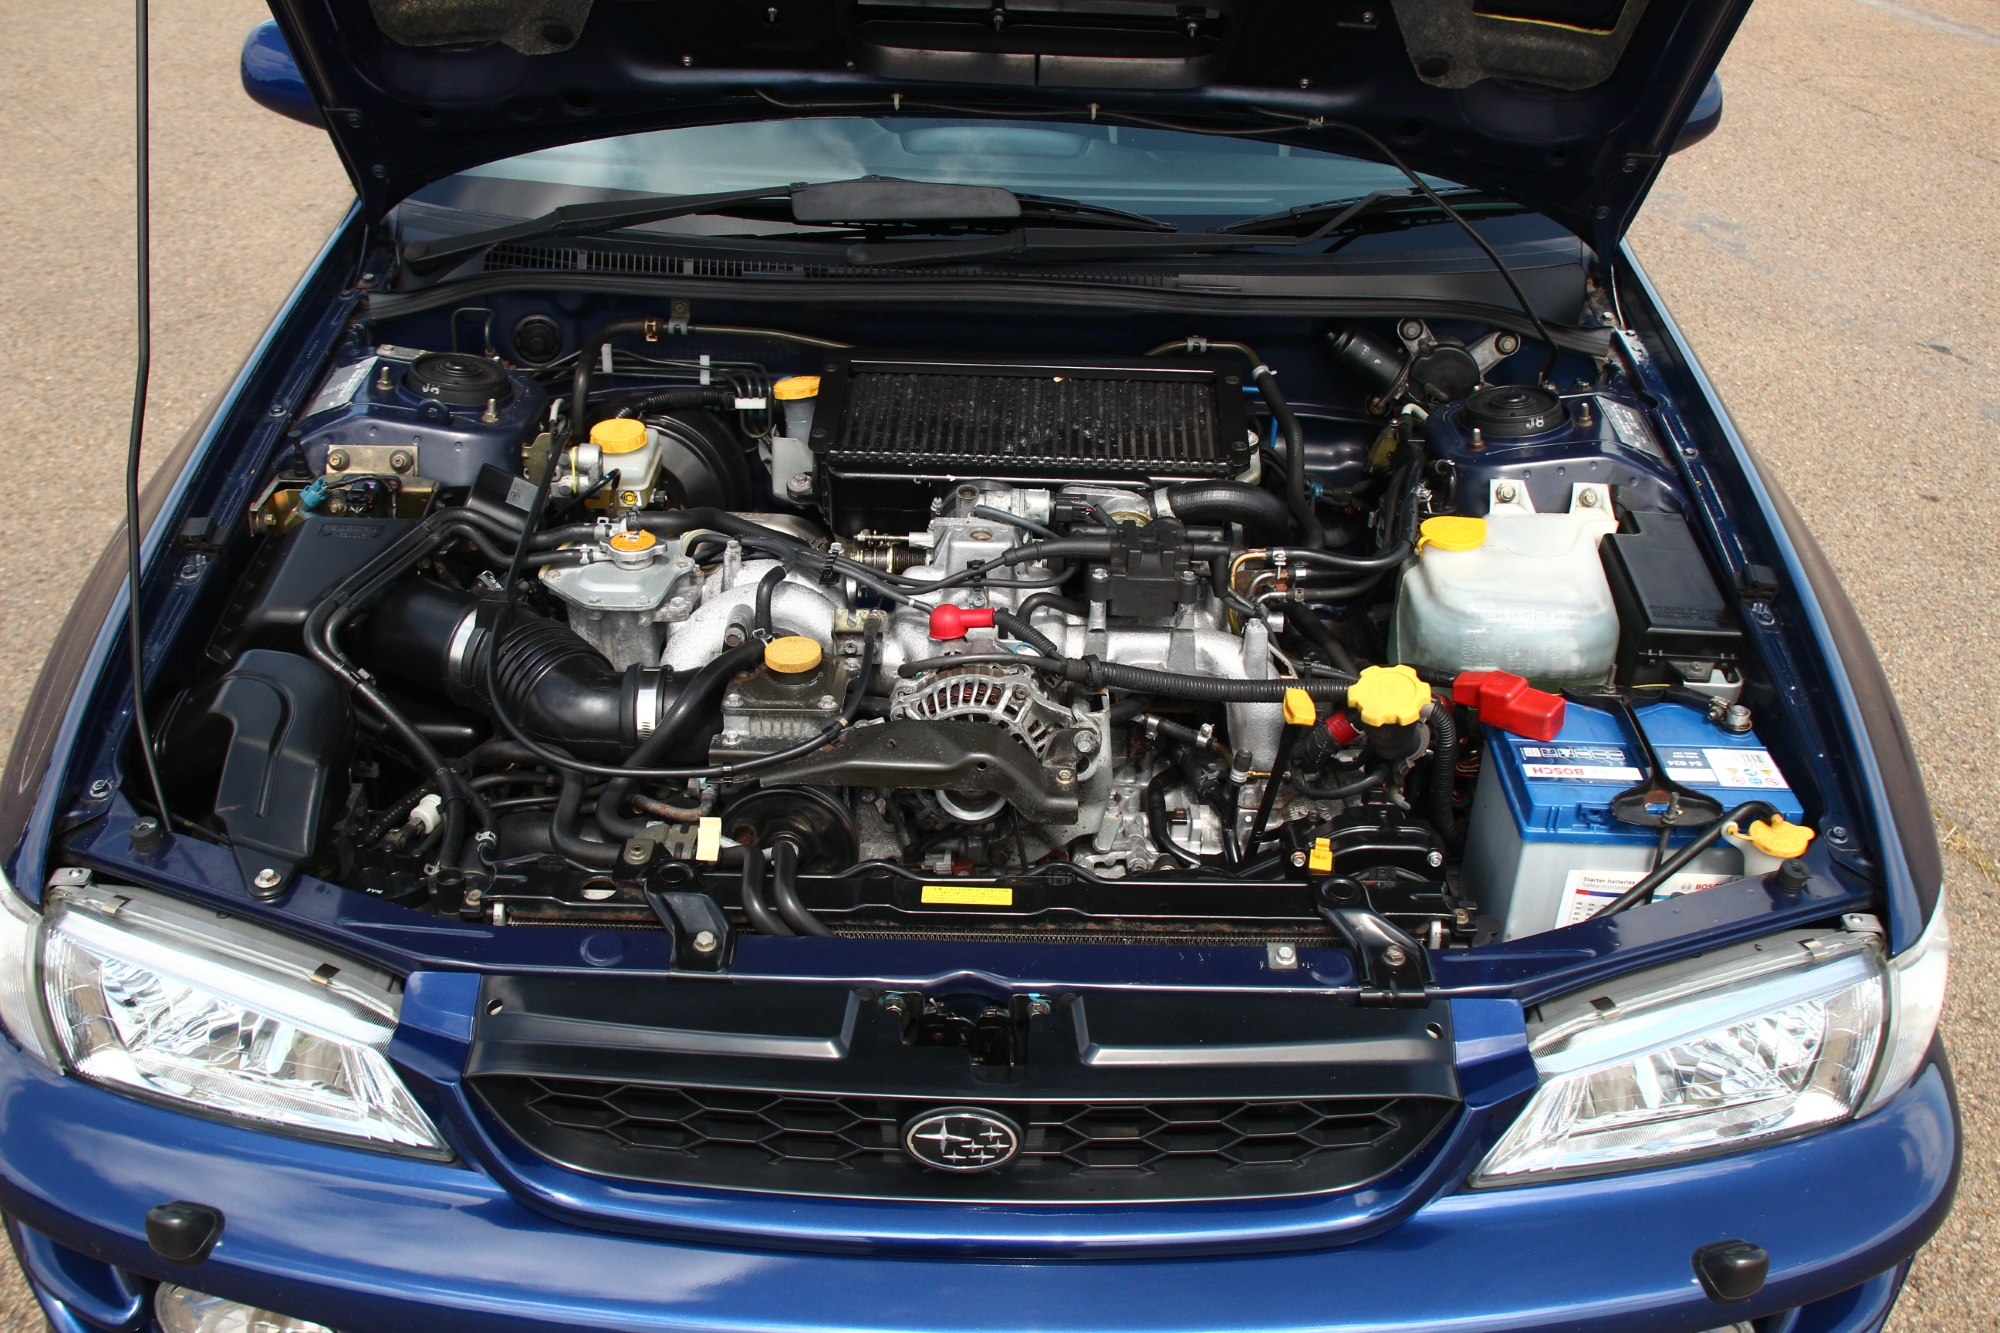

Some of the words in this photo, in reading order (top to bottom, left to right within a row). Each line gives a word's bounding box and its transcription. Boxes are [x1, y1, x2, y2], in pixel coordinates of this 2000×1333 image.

[1532, 766, 1584, 777] BOSCH
[1583, 876, 1606, 884] Starter
[1607, 878, 1636, 886] batteries
[1581, 882, 1603, 891] Safety
[1695, 882, 1725, 891] BOSC
